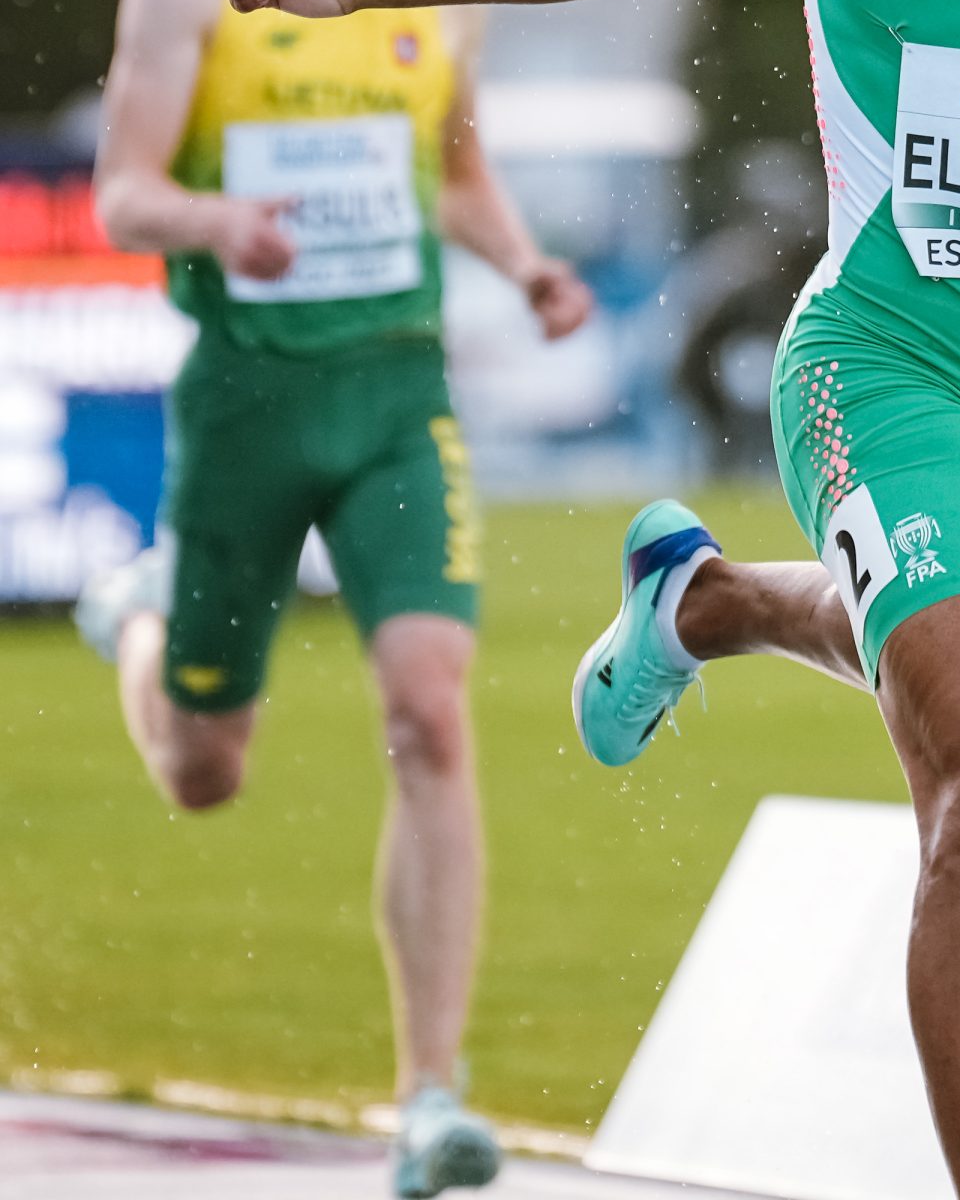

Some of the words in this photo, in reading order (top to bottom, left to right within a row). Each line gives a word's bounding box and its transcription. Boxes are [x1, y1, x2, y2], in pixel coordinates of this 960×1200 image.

[949, 208, 955, 226] I
[835, 529, 872, 607] 2
[906, 559, 947, 589] FPA
